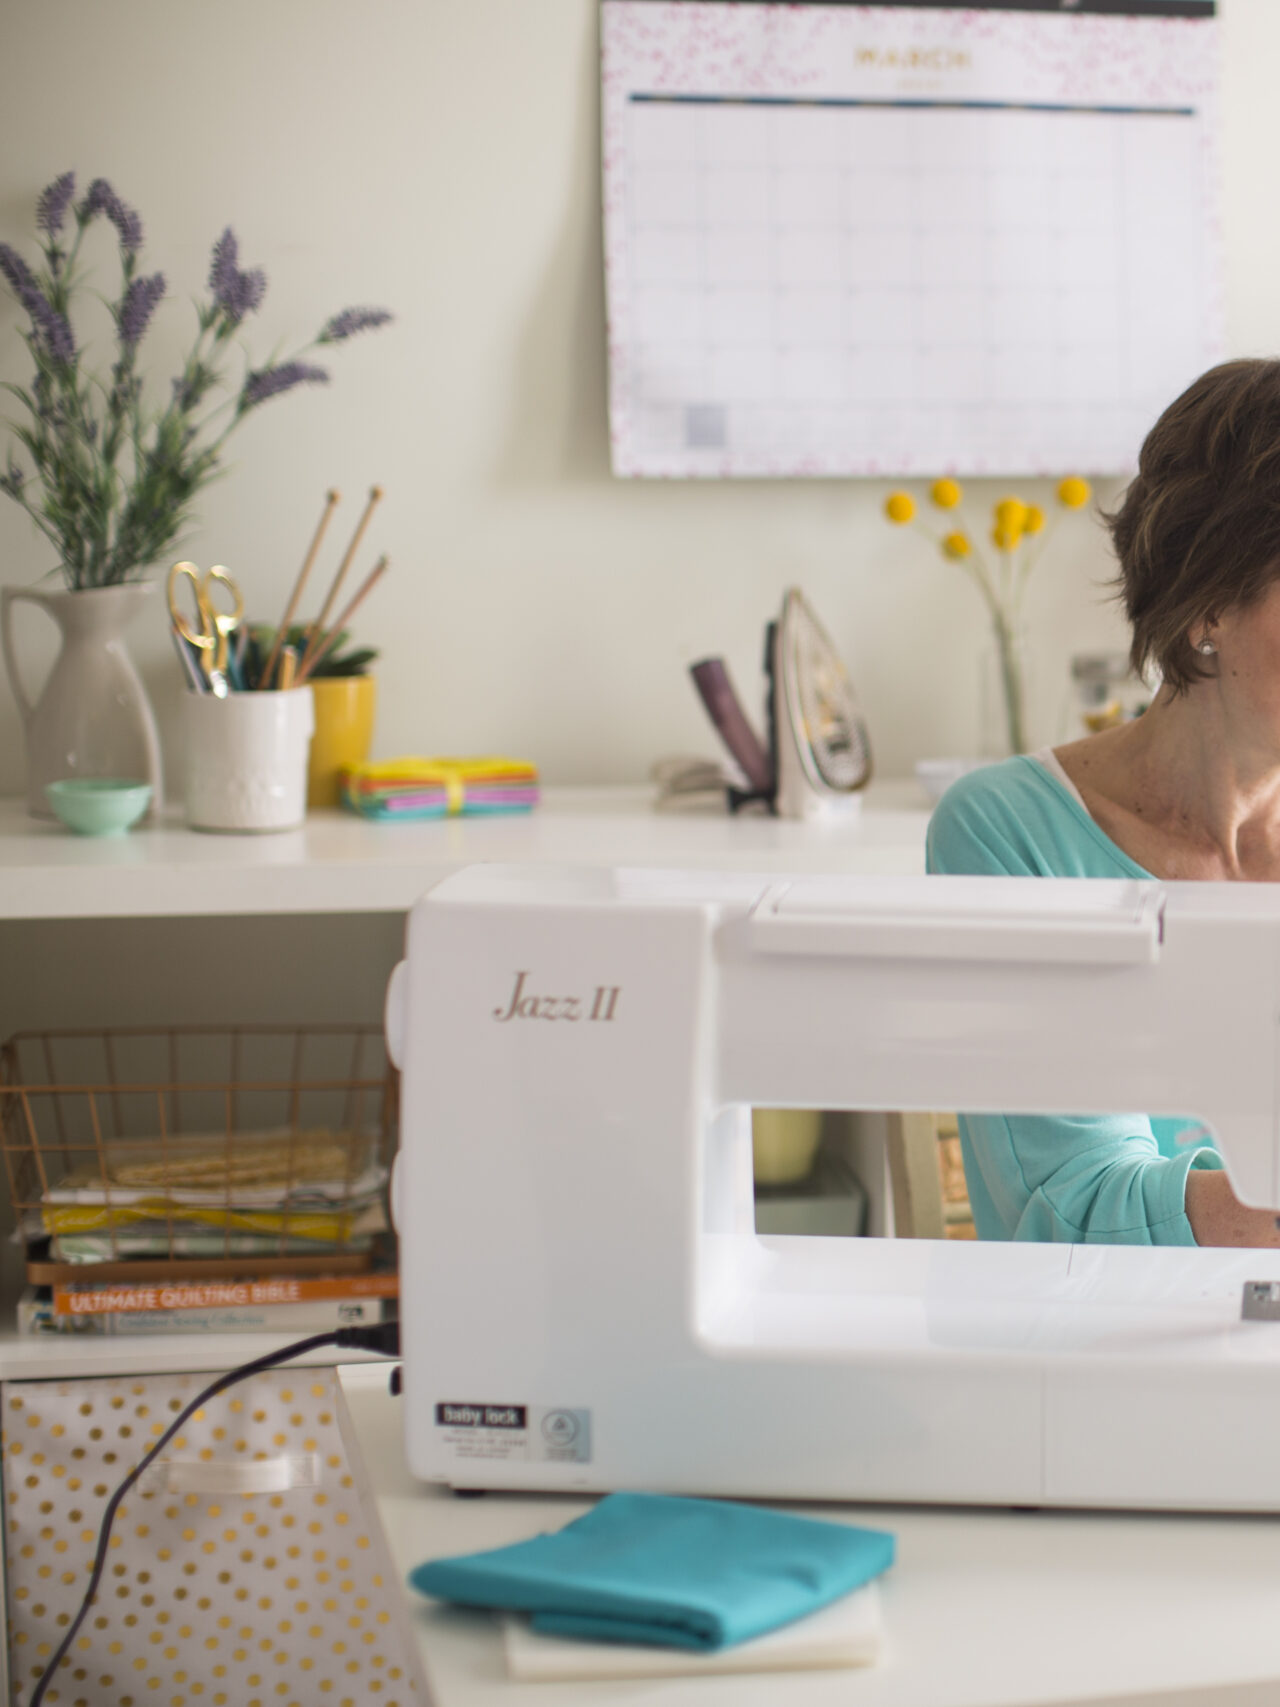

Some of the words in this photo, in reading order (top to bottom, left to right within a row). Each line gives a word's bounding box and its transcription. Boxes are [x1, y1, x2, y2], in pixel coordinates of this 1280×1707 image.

[854, 46, 972, 71] MARCH
[492, 970, 580, 1021] Jazz
[69, 1290, 158, 1312] ULTIMATE
[160, 1284, 248, 1308] QUILTING
[251, 1280, 299, 1302] BIBLE
[443, 1405, 481, 1426] baby
[485, 1407, 520, 1425] lock
